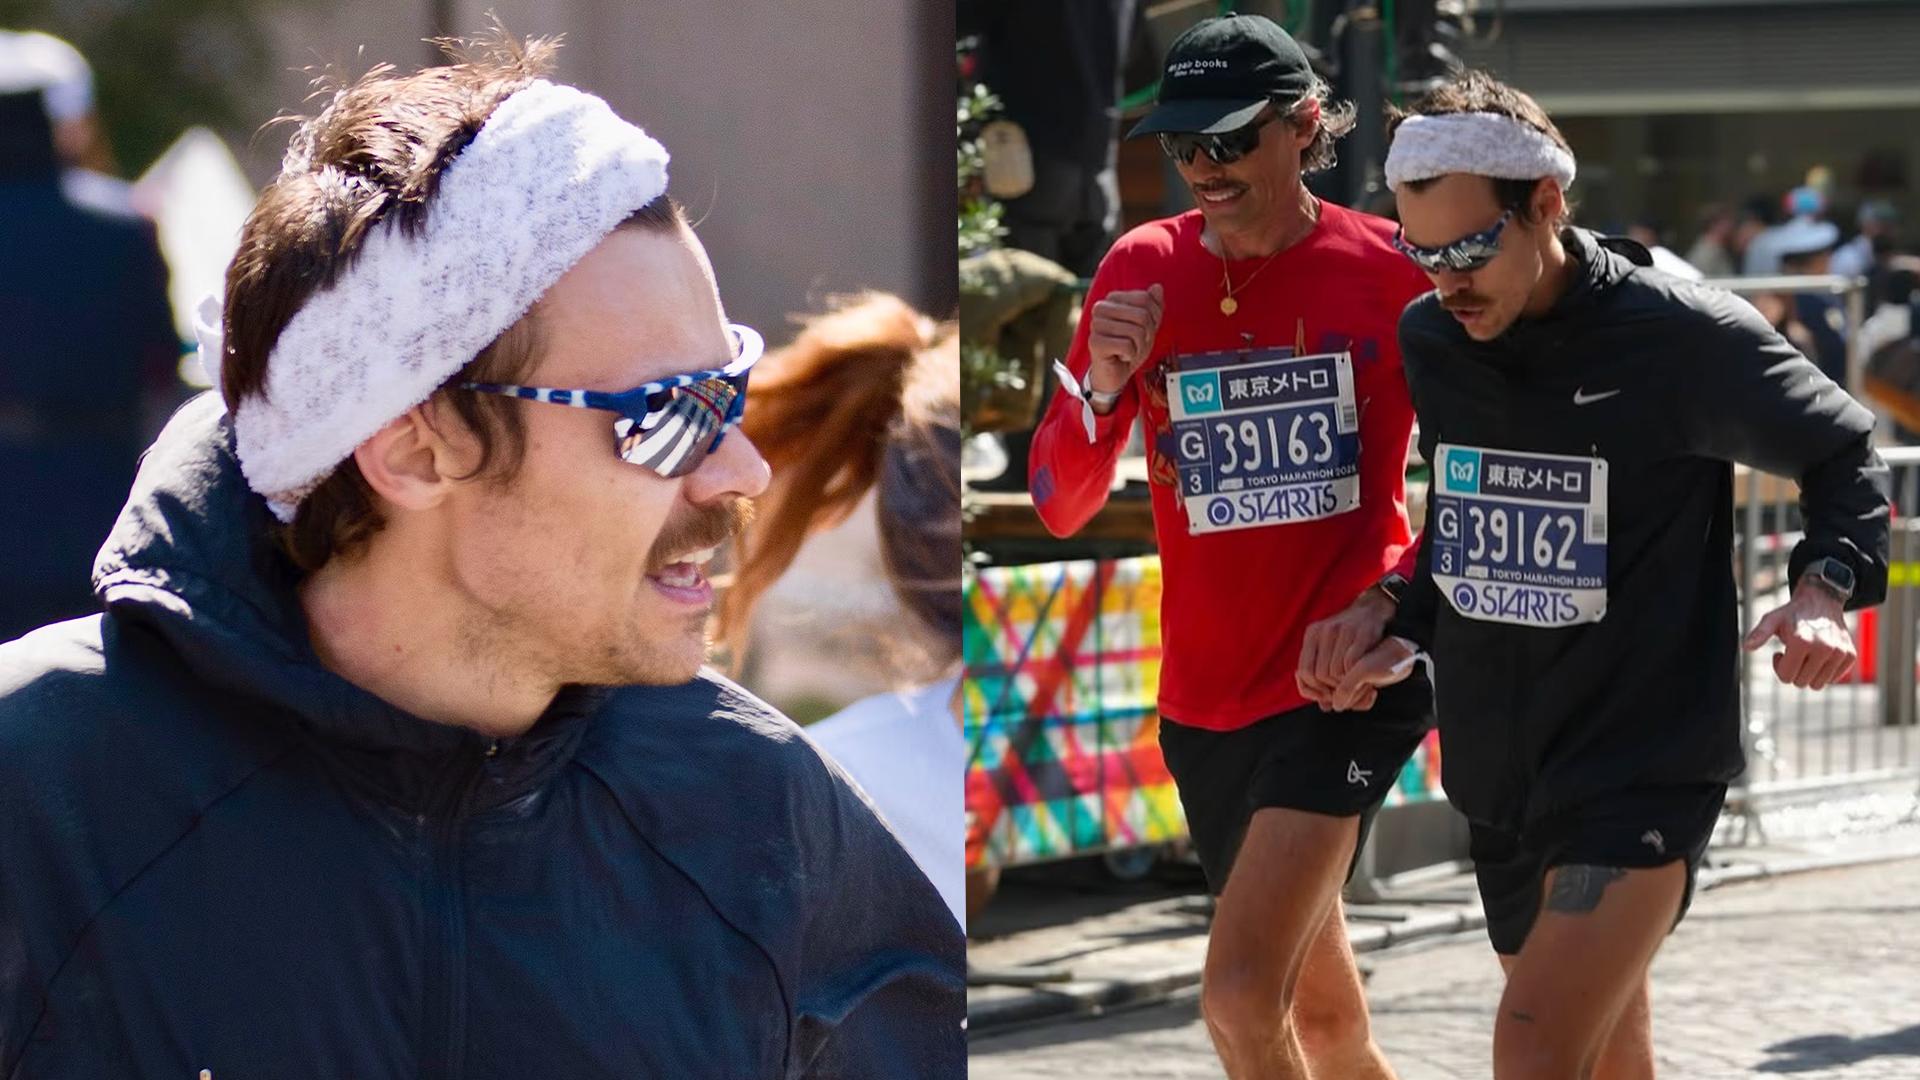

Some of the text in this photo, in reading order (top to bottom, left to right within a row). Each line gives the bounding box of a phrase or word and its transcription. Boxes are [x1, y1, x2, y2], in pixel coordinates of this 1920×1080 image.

[1195, 58, 1228, 68] books
[1228, 369, 1329, 400] 東京メトロ
[1180, 431, 1205, 460] G
[1215, 411, 1333, 474] 39163
[1189, 474, 1202, 494] 3
[1247, 471, 1279, 487] TOKYO
[1280, 466, 1334, 483] MARATHON
[1487, 463, 1582, 492] 東京メトロ
[1438, 507, 1458, 539] G
[1468, 506, 1577, 571] 39162
[1440, 552, 1453, 573] 3
[1492, 568, 1523, 582] TOKYO
[1523, 571, 1575, 587] MARATHON
[1576, 577, 1603, 588] 2025
